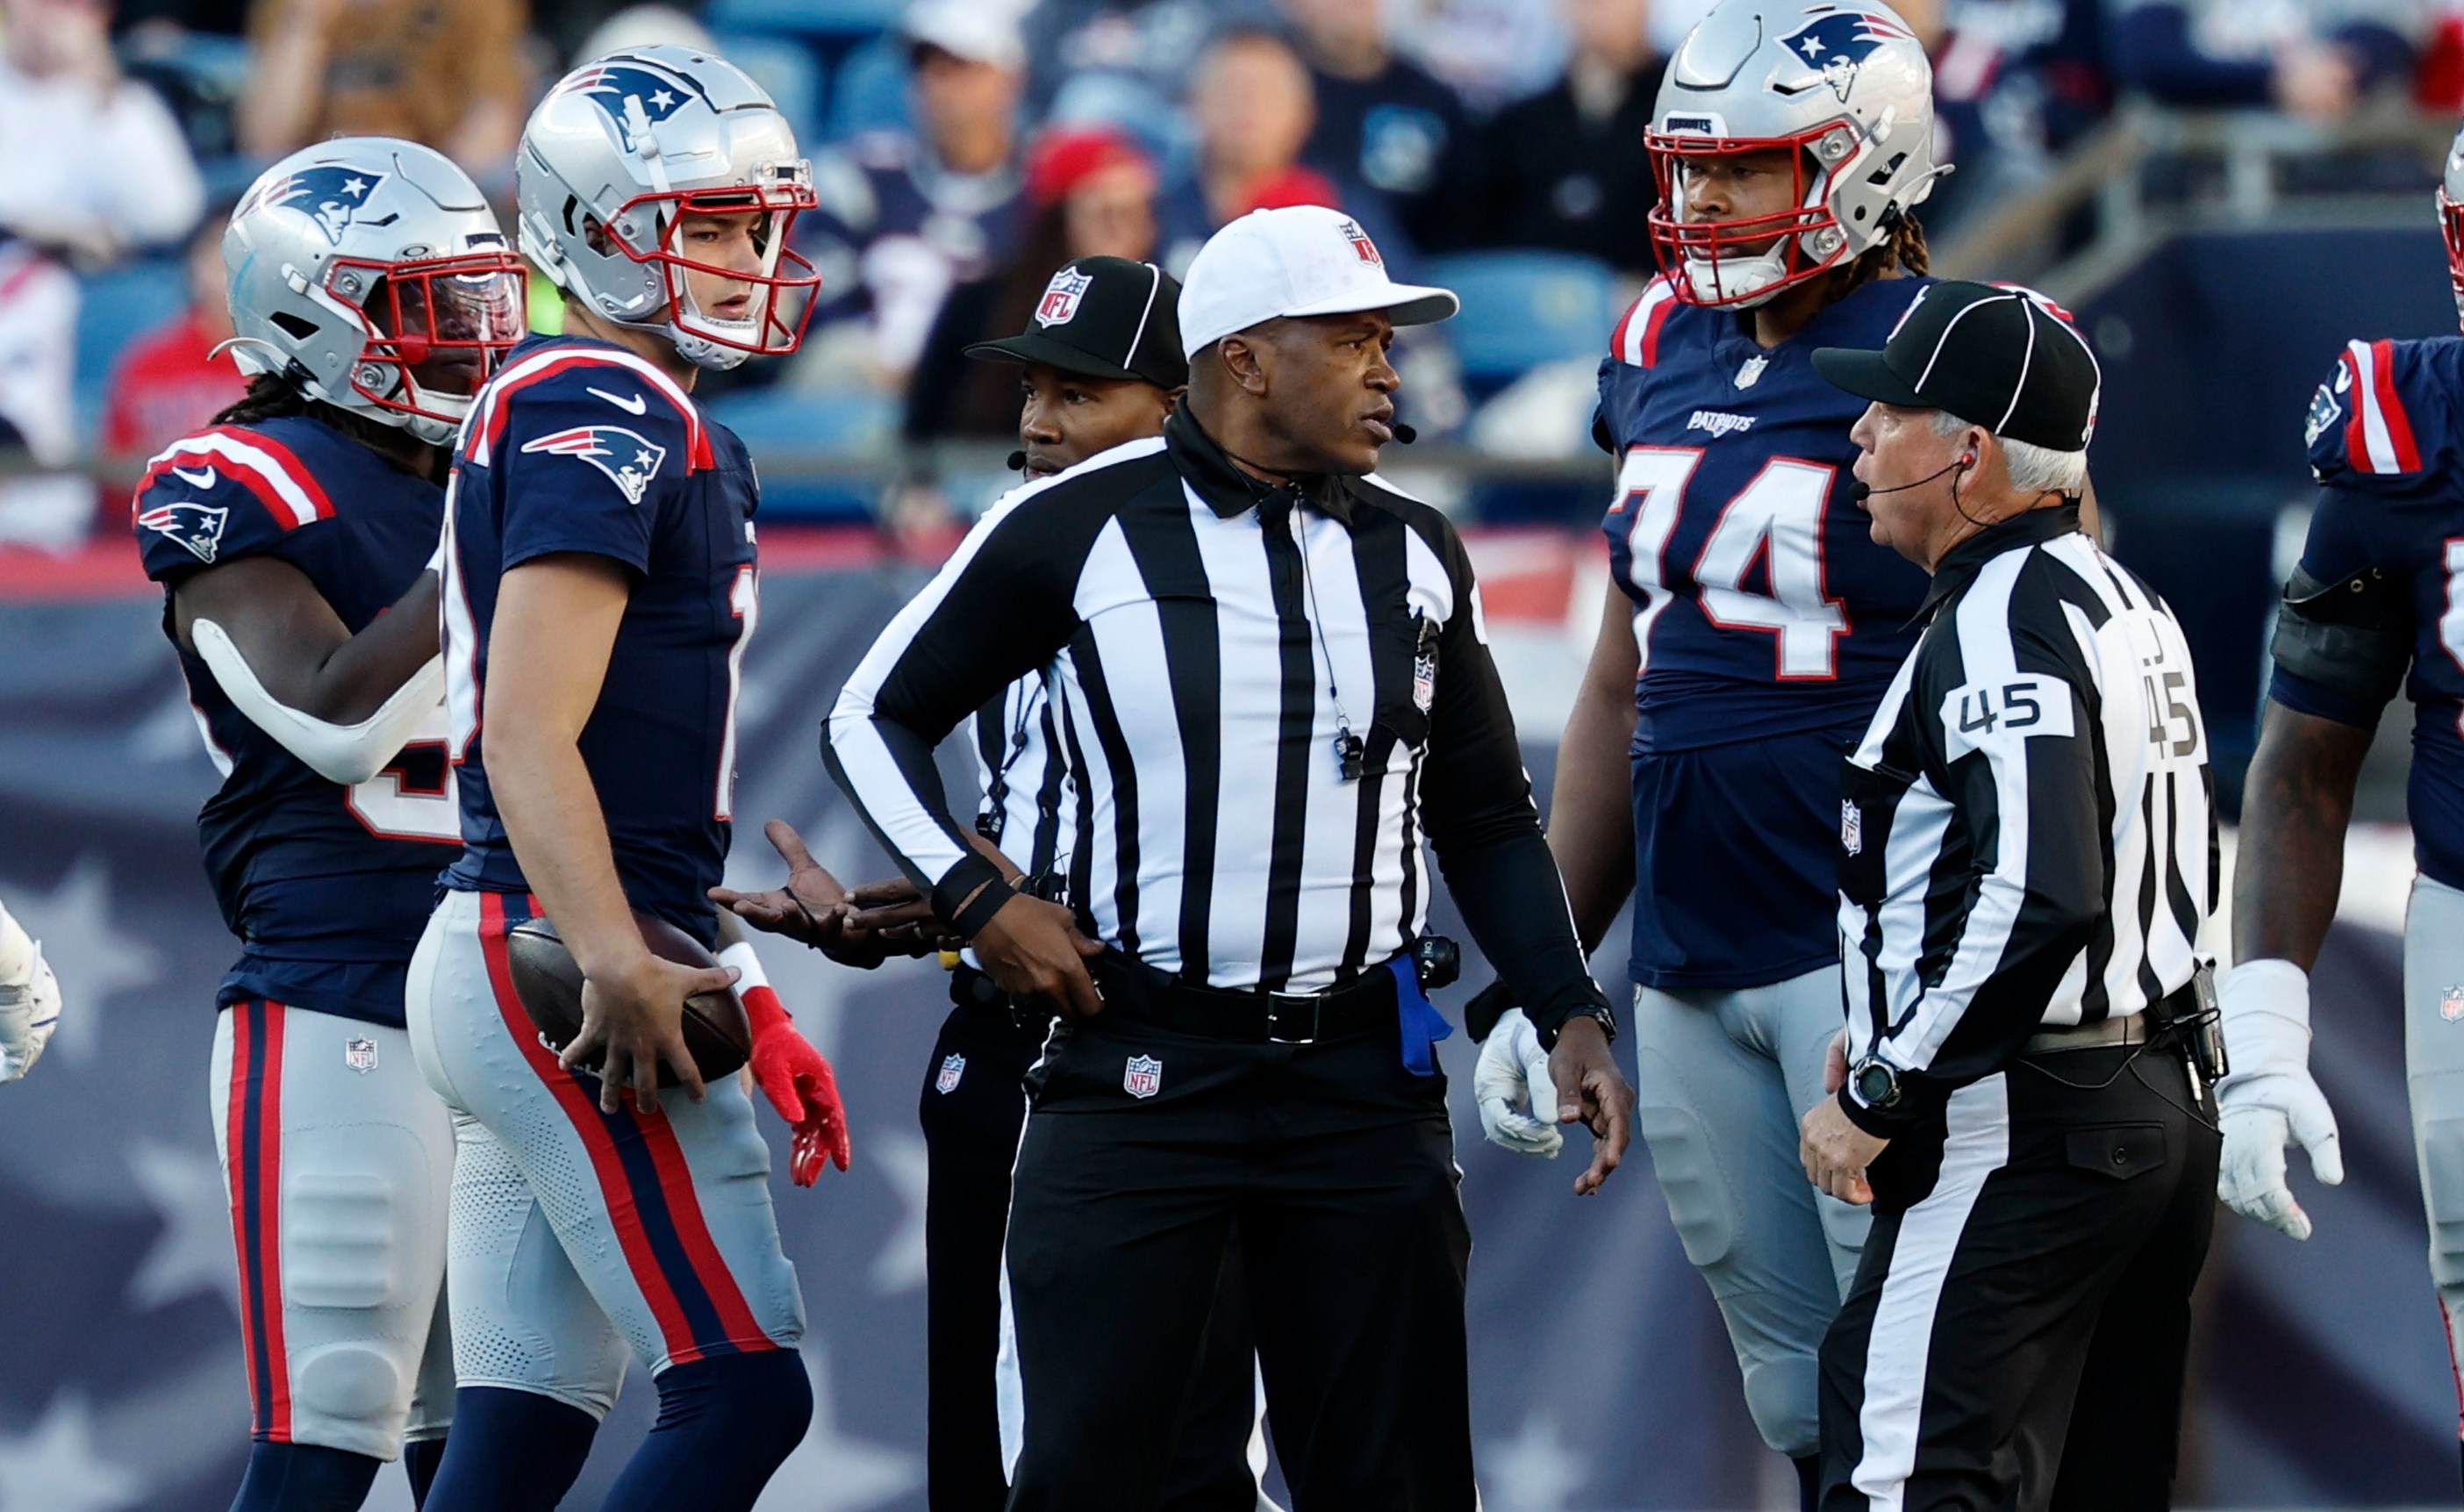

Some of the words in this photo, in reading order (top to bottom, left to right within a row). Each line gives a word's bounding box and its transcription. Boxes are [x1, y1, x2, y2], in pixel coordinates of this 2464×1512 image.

[1041, 292, 1072, 319] NFL
[1687, 411, 1757, 433] PATRIOTS
[1608, 444, 1852, 681] 74
[1959, 682, 2041, 735] 45
[2144, 671, 2198, 759] 45
[1129, 1073, 1157, 1092] NFL
